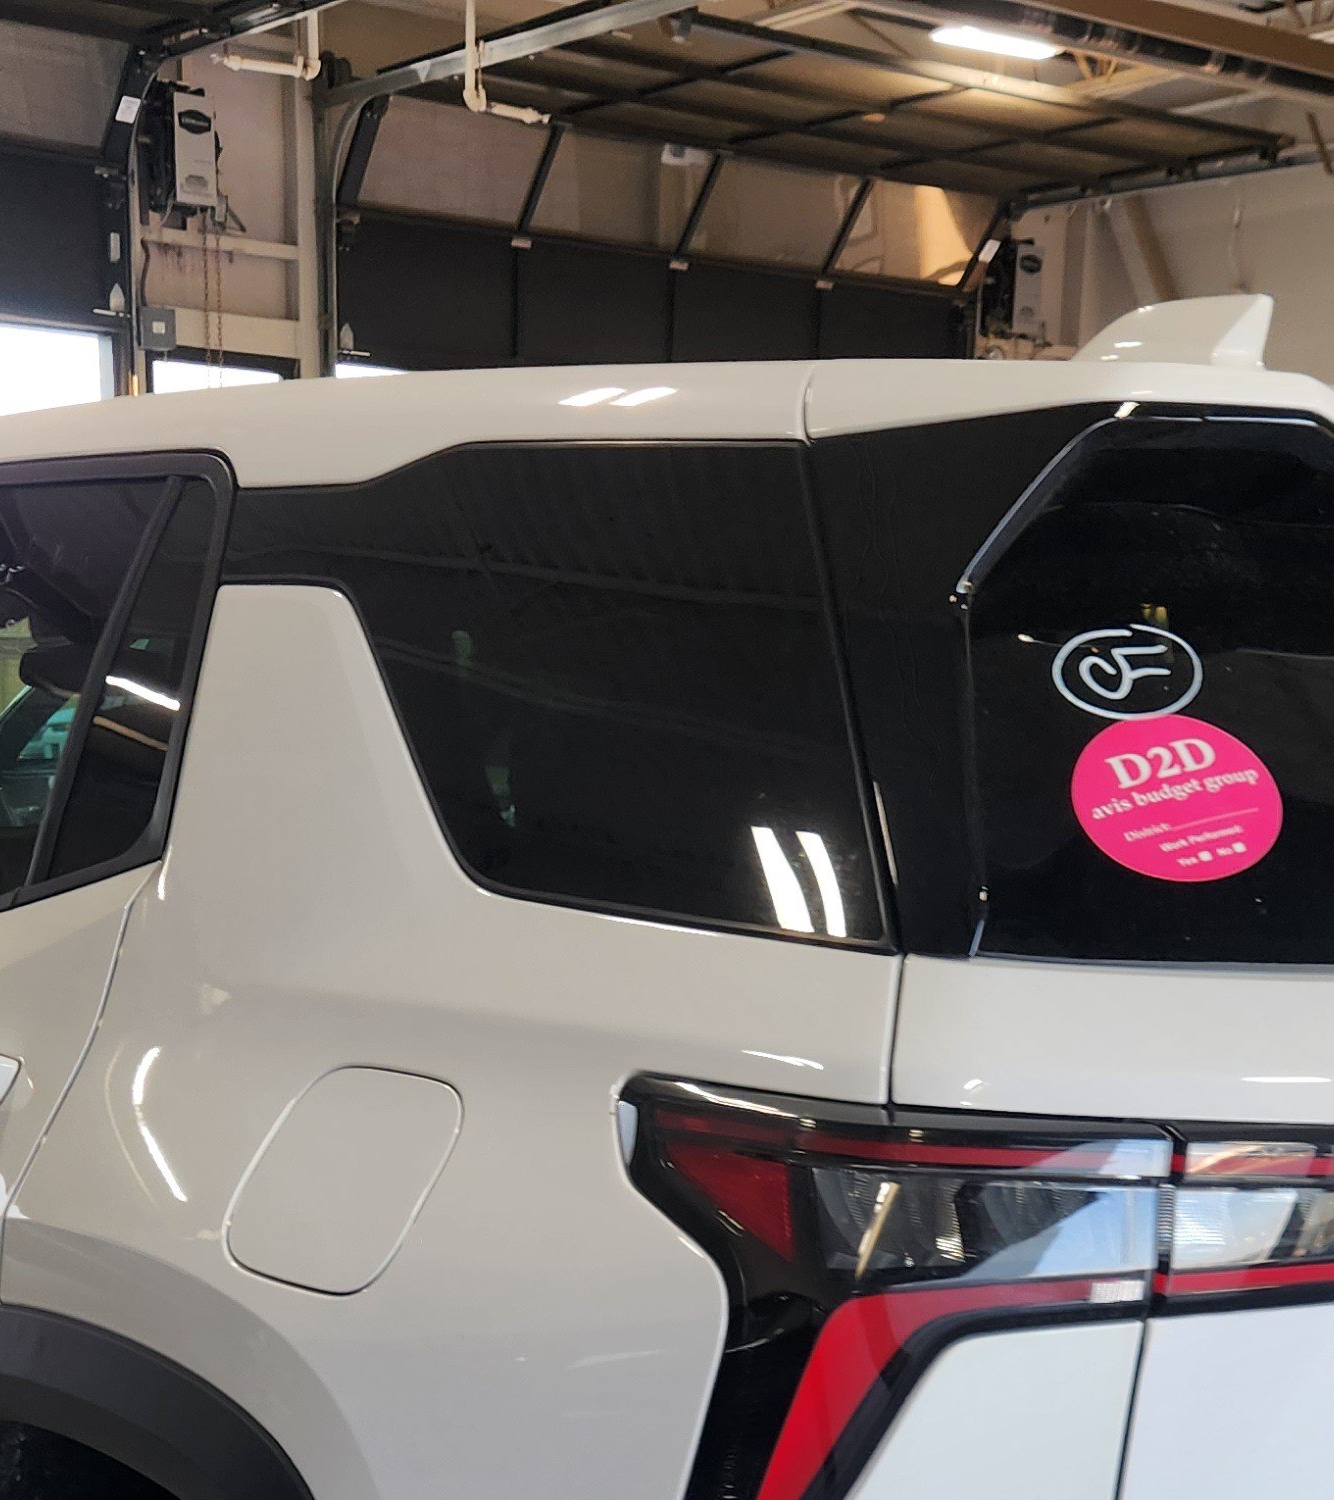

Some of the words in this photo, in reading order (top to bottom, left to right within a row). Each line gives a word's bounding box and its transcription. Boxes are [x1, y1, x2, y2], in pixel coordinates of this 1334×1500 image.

[1104, 738, 1216, 790] D2D
[1091, 797, 1133, 820] avis
[1131, 778, 1204, 807] budget
[1202, 768, 1260, 793] group
